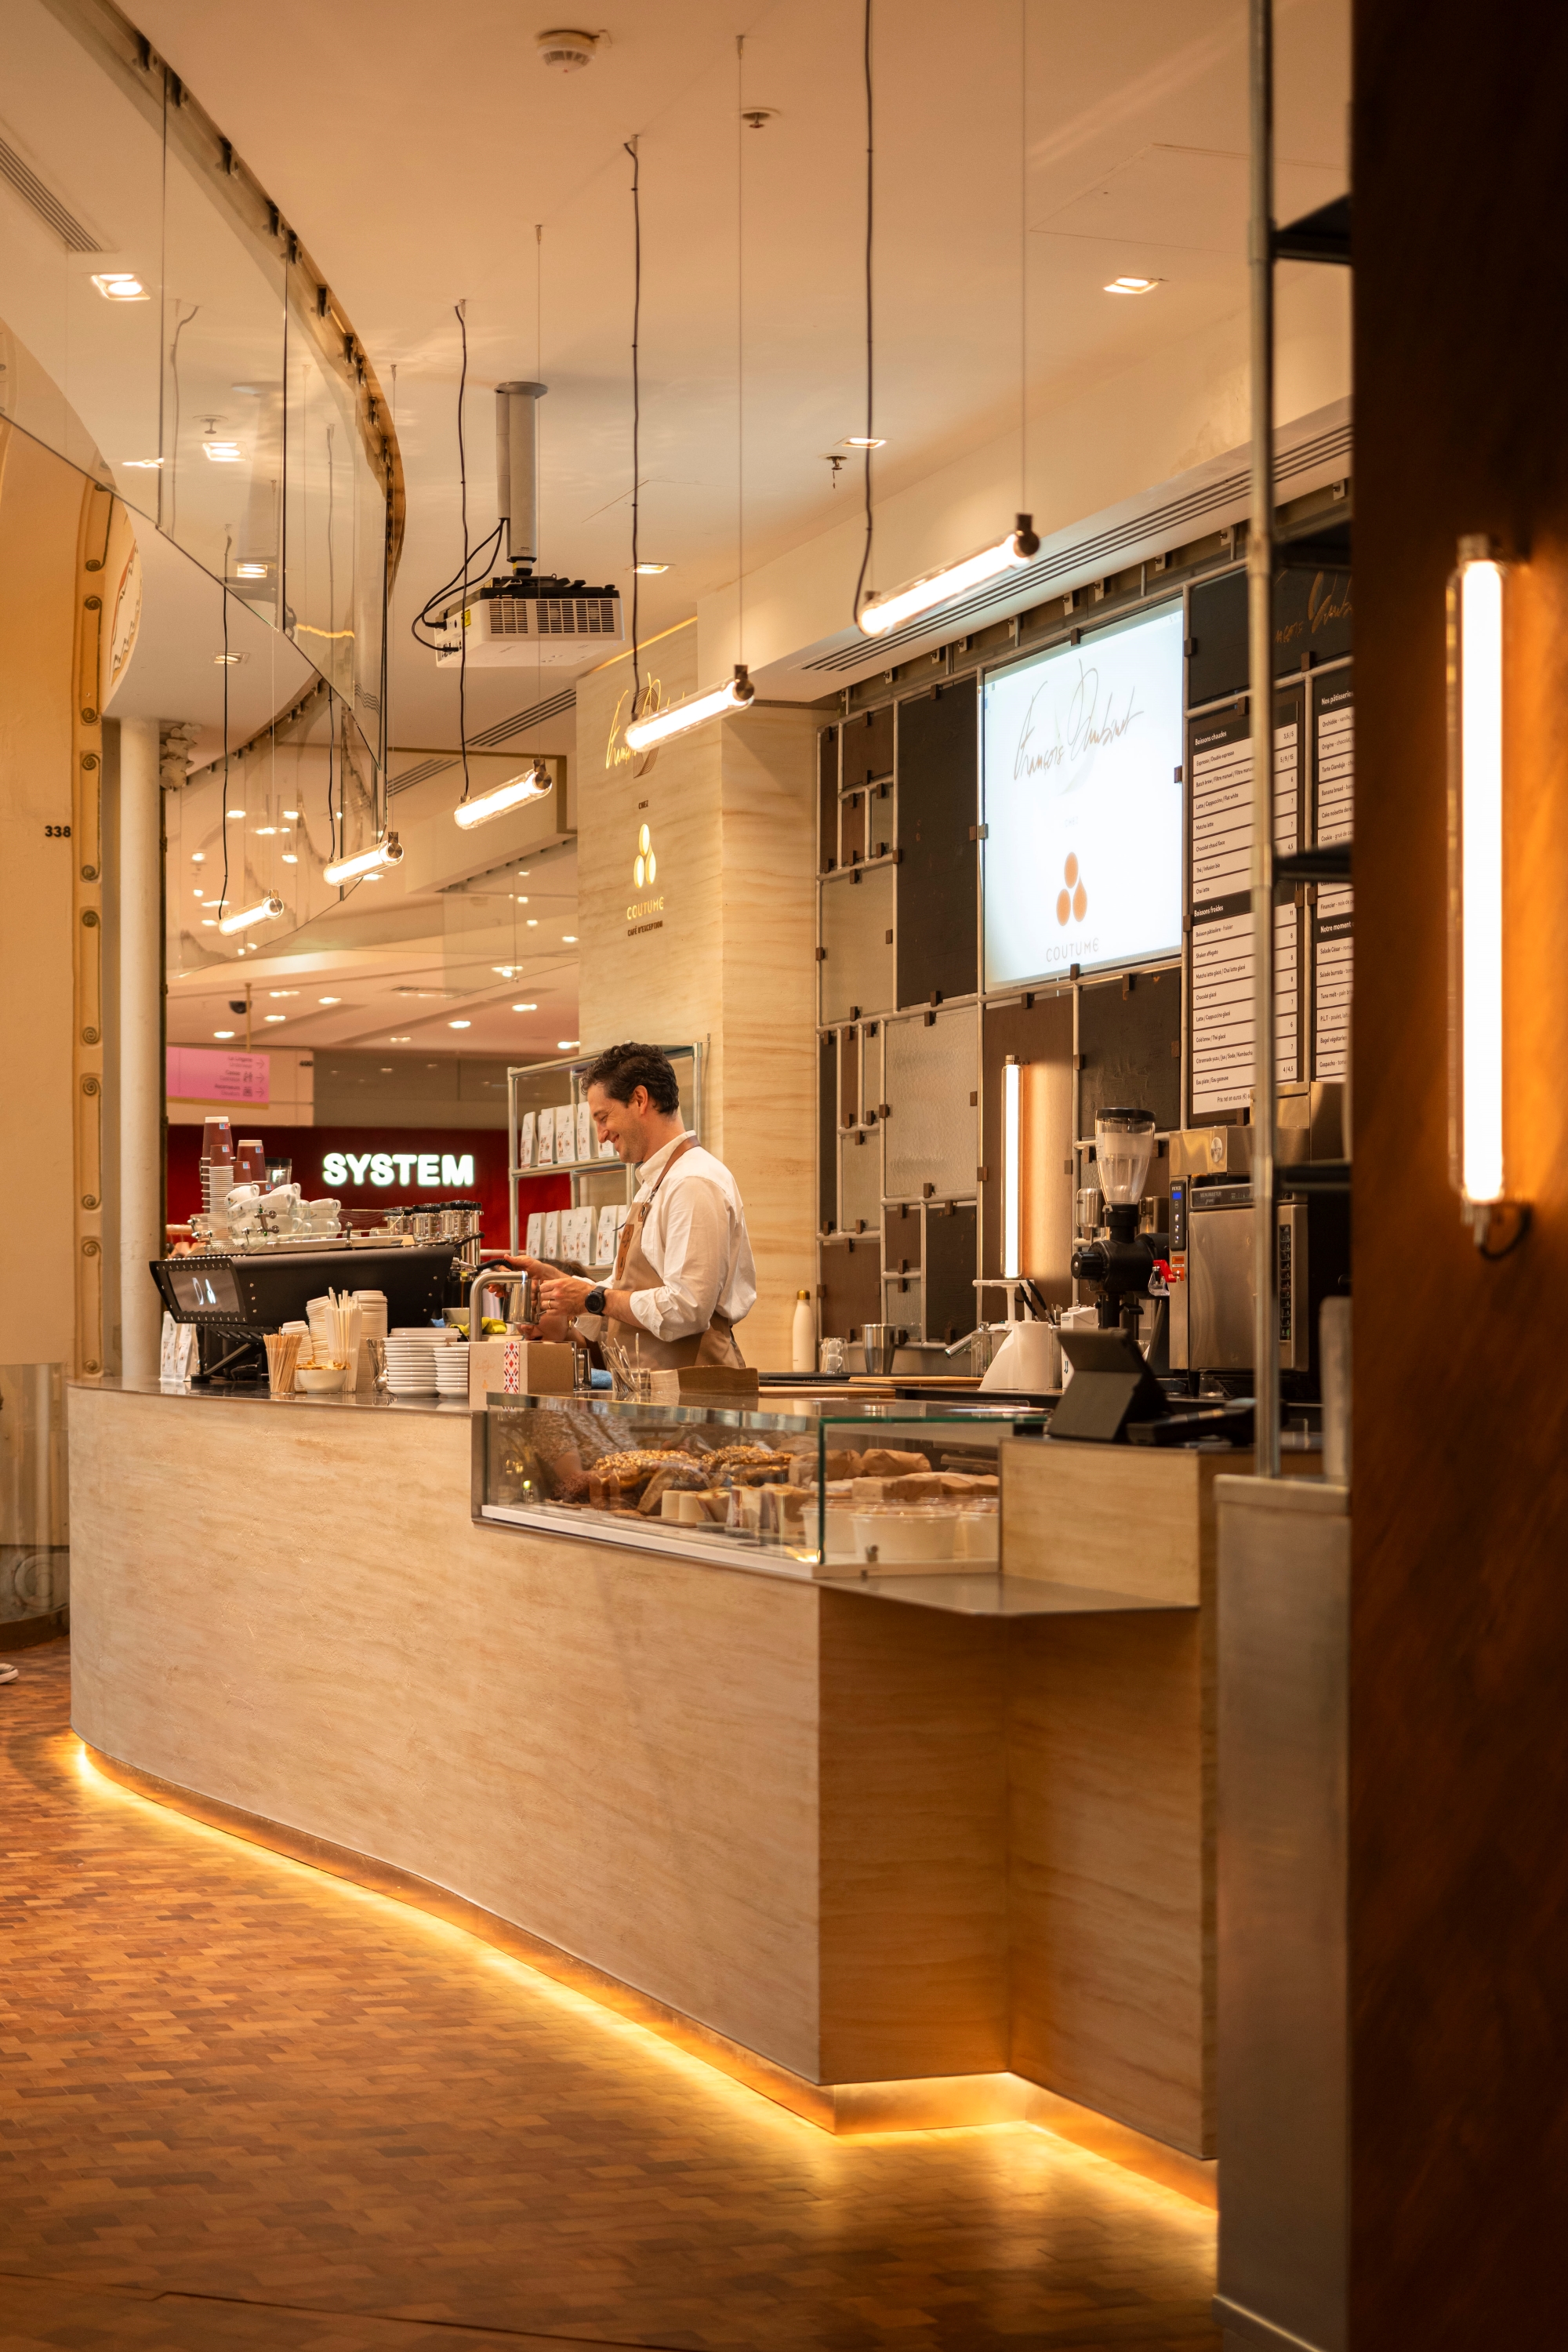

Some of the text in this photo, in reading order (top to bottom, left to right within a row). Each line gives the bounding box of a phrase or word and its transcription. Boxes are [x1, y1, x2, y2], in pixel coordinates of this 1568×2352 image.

[1195, 731, 1227, 745] Boissons chaudes
[1206, 798, 1222, 806] Cappuccino
[45, 825, 71, 838] 338
[627, 896, 664, 920] COUTUME
[1194, 905, 1223, 917] Boissons froides
[628, 925, 637, 937] CAFÉ
[1333, 921, 1351, 930] moment
[1046, 938, 1099, 963] COUTUME
[322, 1152, 474, 1187] SYSTEM
